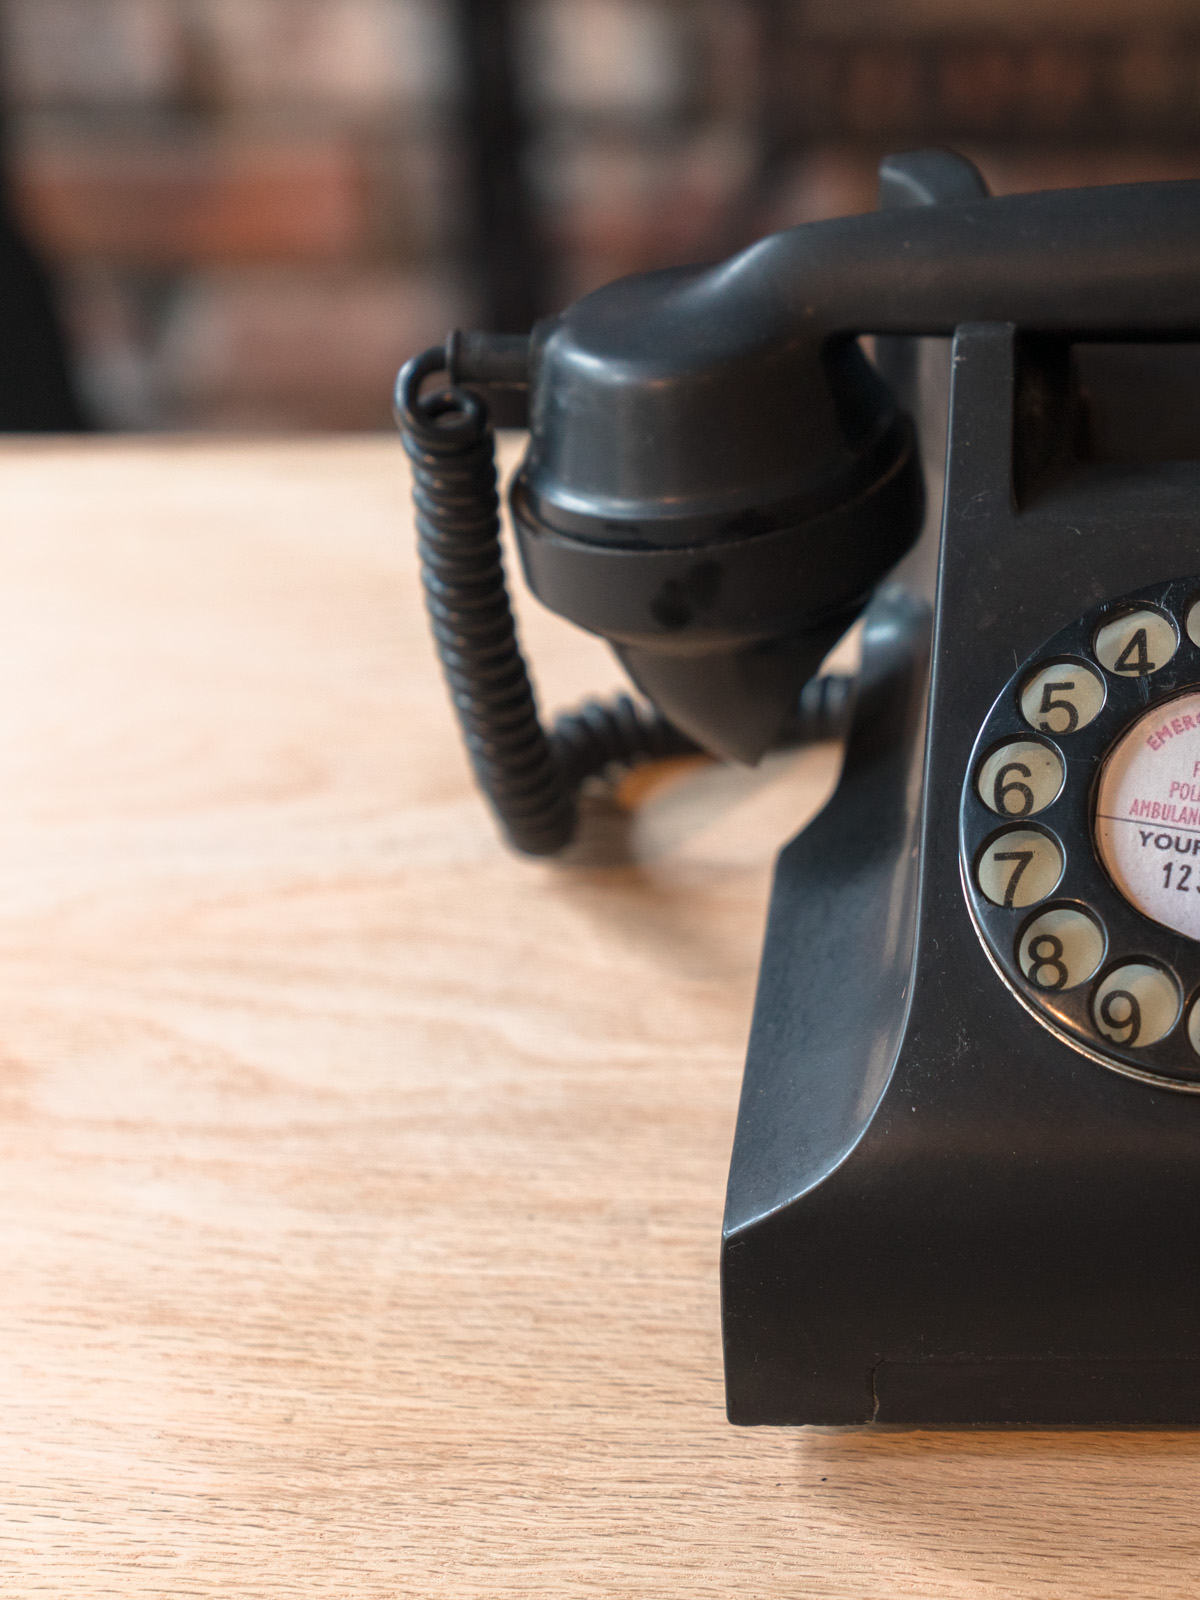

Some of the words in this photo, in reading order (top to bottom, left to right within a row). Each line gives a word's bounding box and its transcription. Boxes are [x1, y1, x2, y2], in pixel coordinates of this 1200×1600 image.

[1114, 628, 1155, 675] 4
[1039, 682, 1078, 735] 5
[994, 762, 1034, 816] 6
[994, 851, 1033, 908] 7
[1028, 934, 1068, 990] 8
[1101, 989, 1141, 1046] 9
